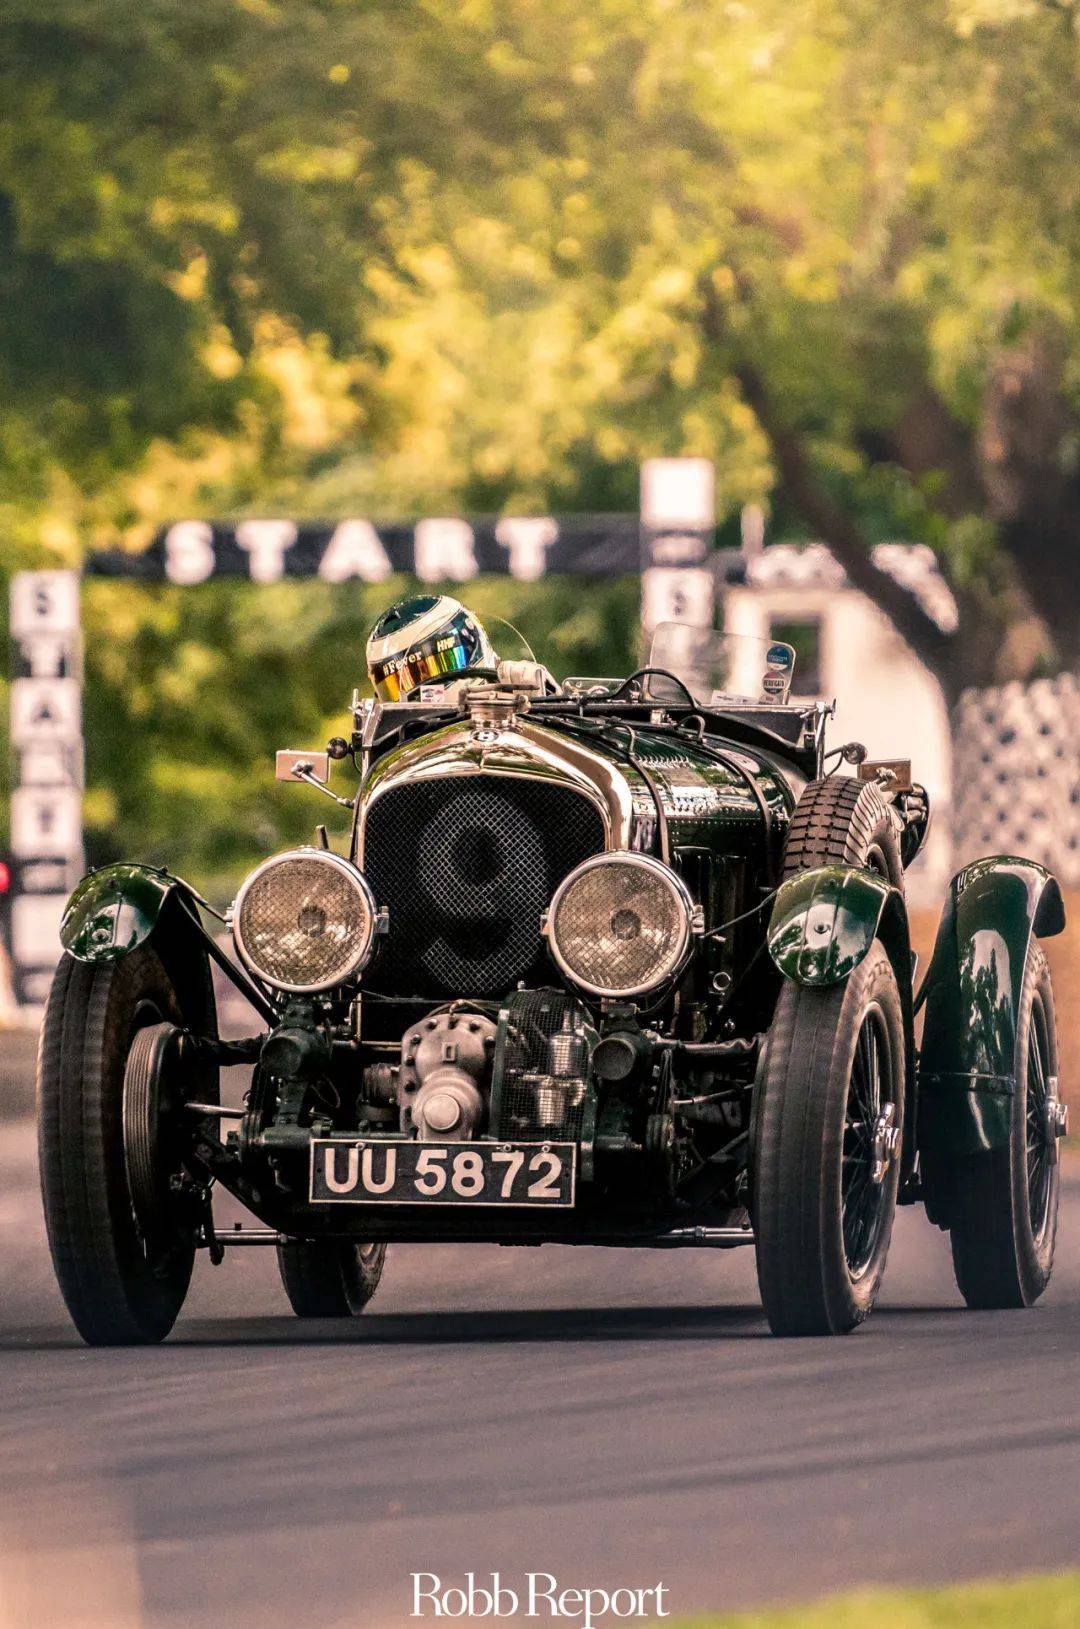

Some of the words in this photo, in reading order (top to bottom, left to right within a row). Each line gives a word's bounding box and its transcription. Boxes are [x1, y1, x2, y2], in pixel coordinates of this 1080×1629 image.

[165, 517, 559, 585] START
[419, 792, 550, 994] 9
[325, 1148, 397, 1194] UU
[413, 1149, 563, 1199] 5872
